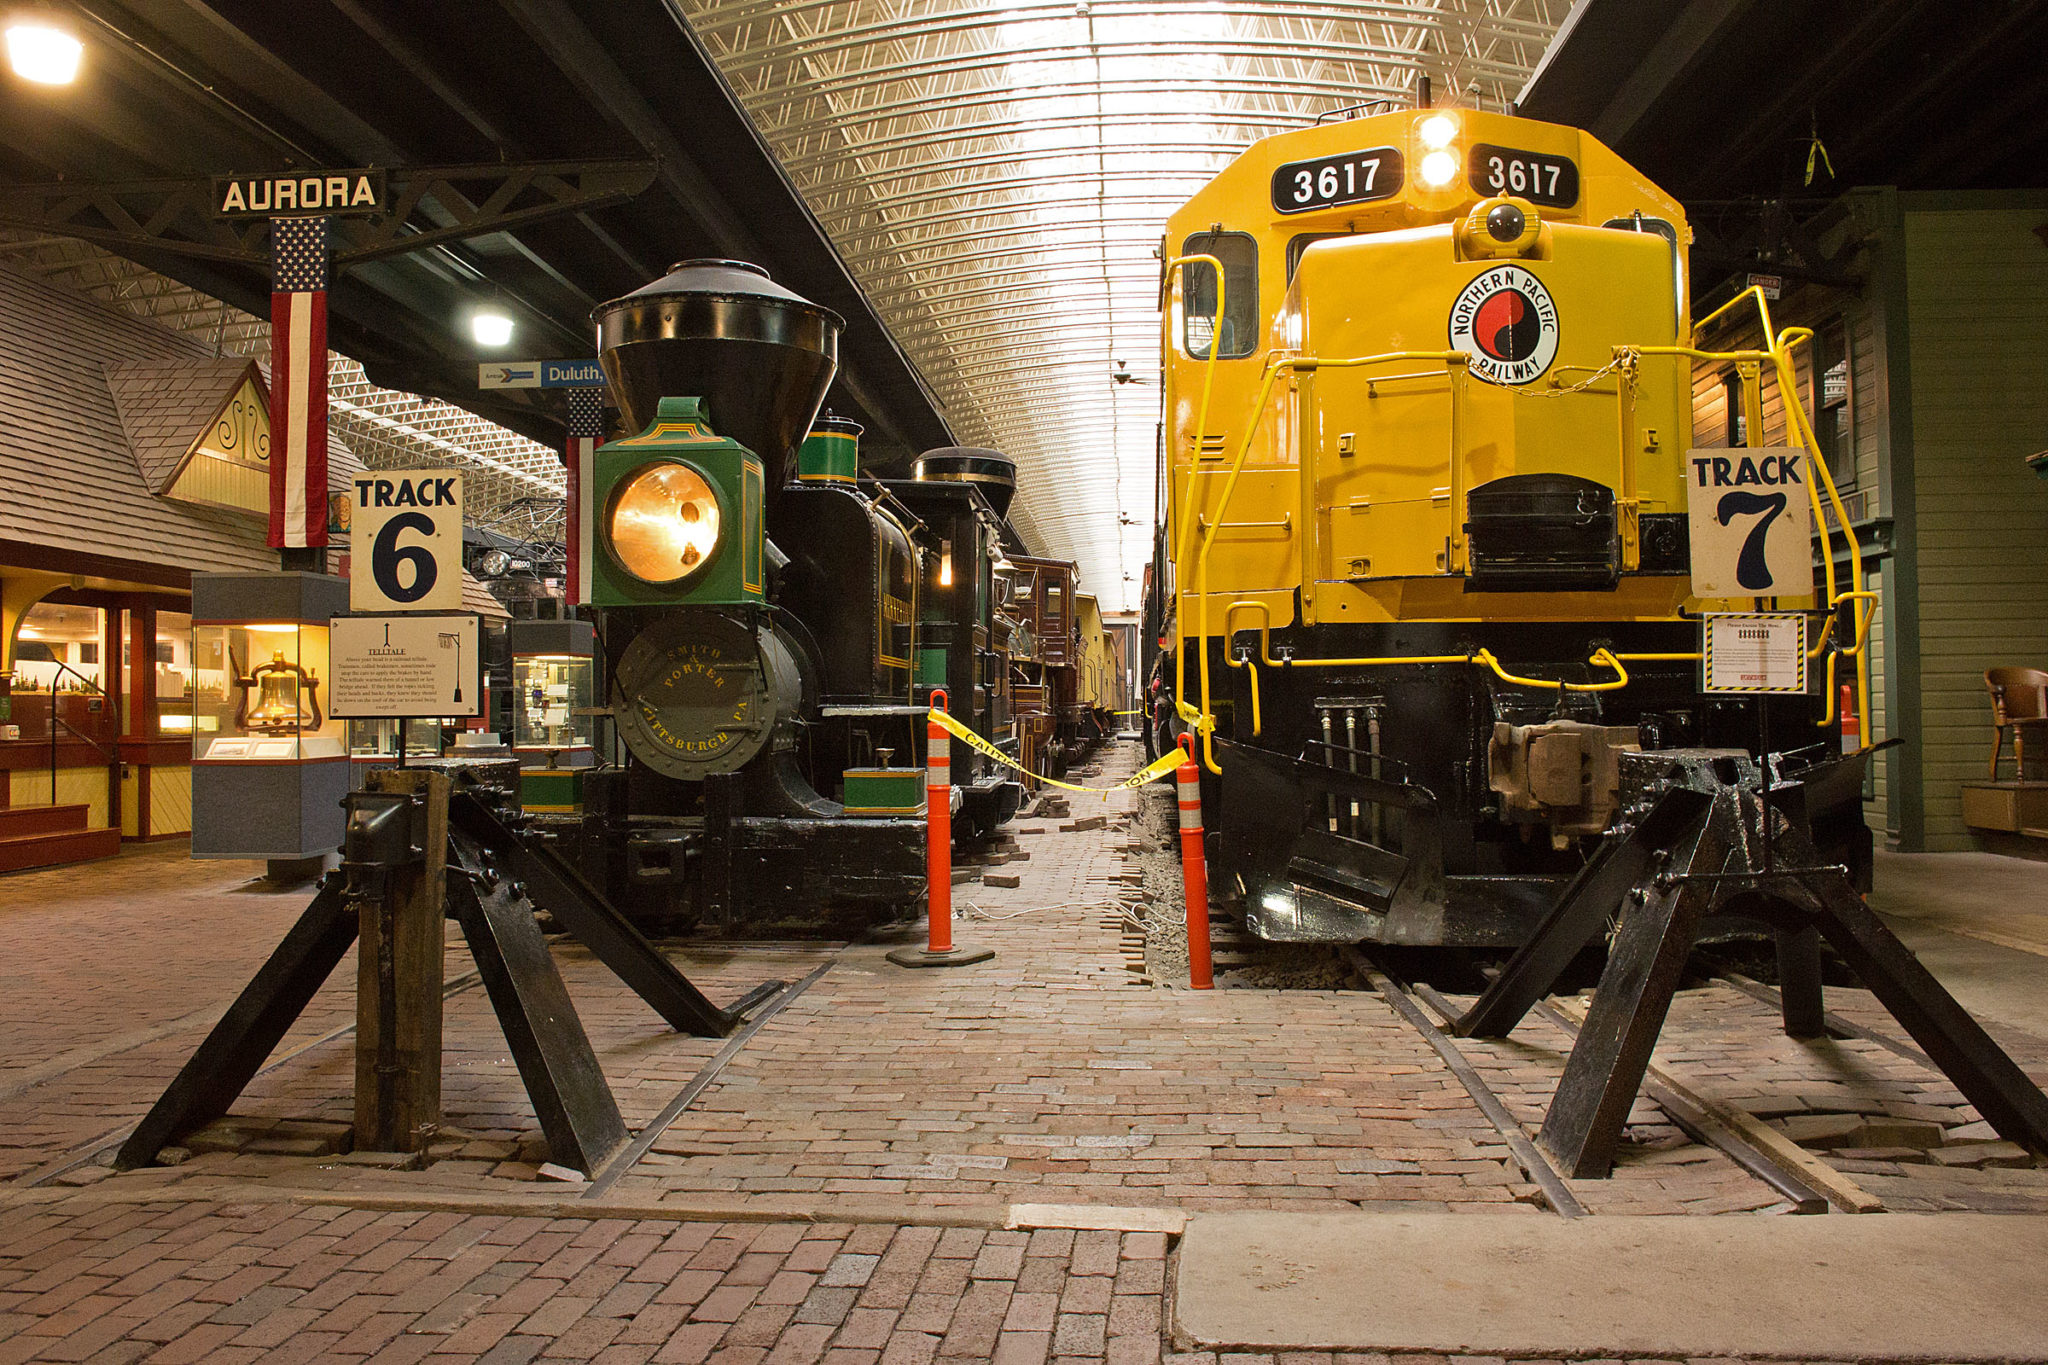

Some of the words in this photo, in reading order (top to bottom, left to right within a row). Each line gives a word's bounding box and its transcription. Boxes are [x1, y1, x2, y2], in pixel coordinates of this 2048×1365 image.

[1293, 158, 1381, 203] 3617
[1488, 156, 1560, 196] 3617
[222, 176, 376, 211] AURORA
[1454, 271, 1514, 336] NORTHERN
[1522, 278, 1554, 333] PACIFIC
[549, 365, 603, 382] Duluth,
[1479, 356, 1540, 379] RAILWAY
[1692, 455, 1802, 487] TRACK
[355, 478, 457, 507] TRACK
[1717, 491, 1787, 590] 7
[372, 511, 438, 603] 6
[368, 648, 407, 656] TELLTALE
[664, 663, 725, 688] PORTER
[733, 702, 747, 721] PA
